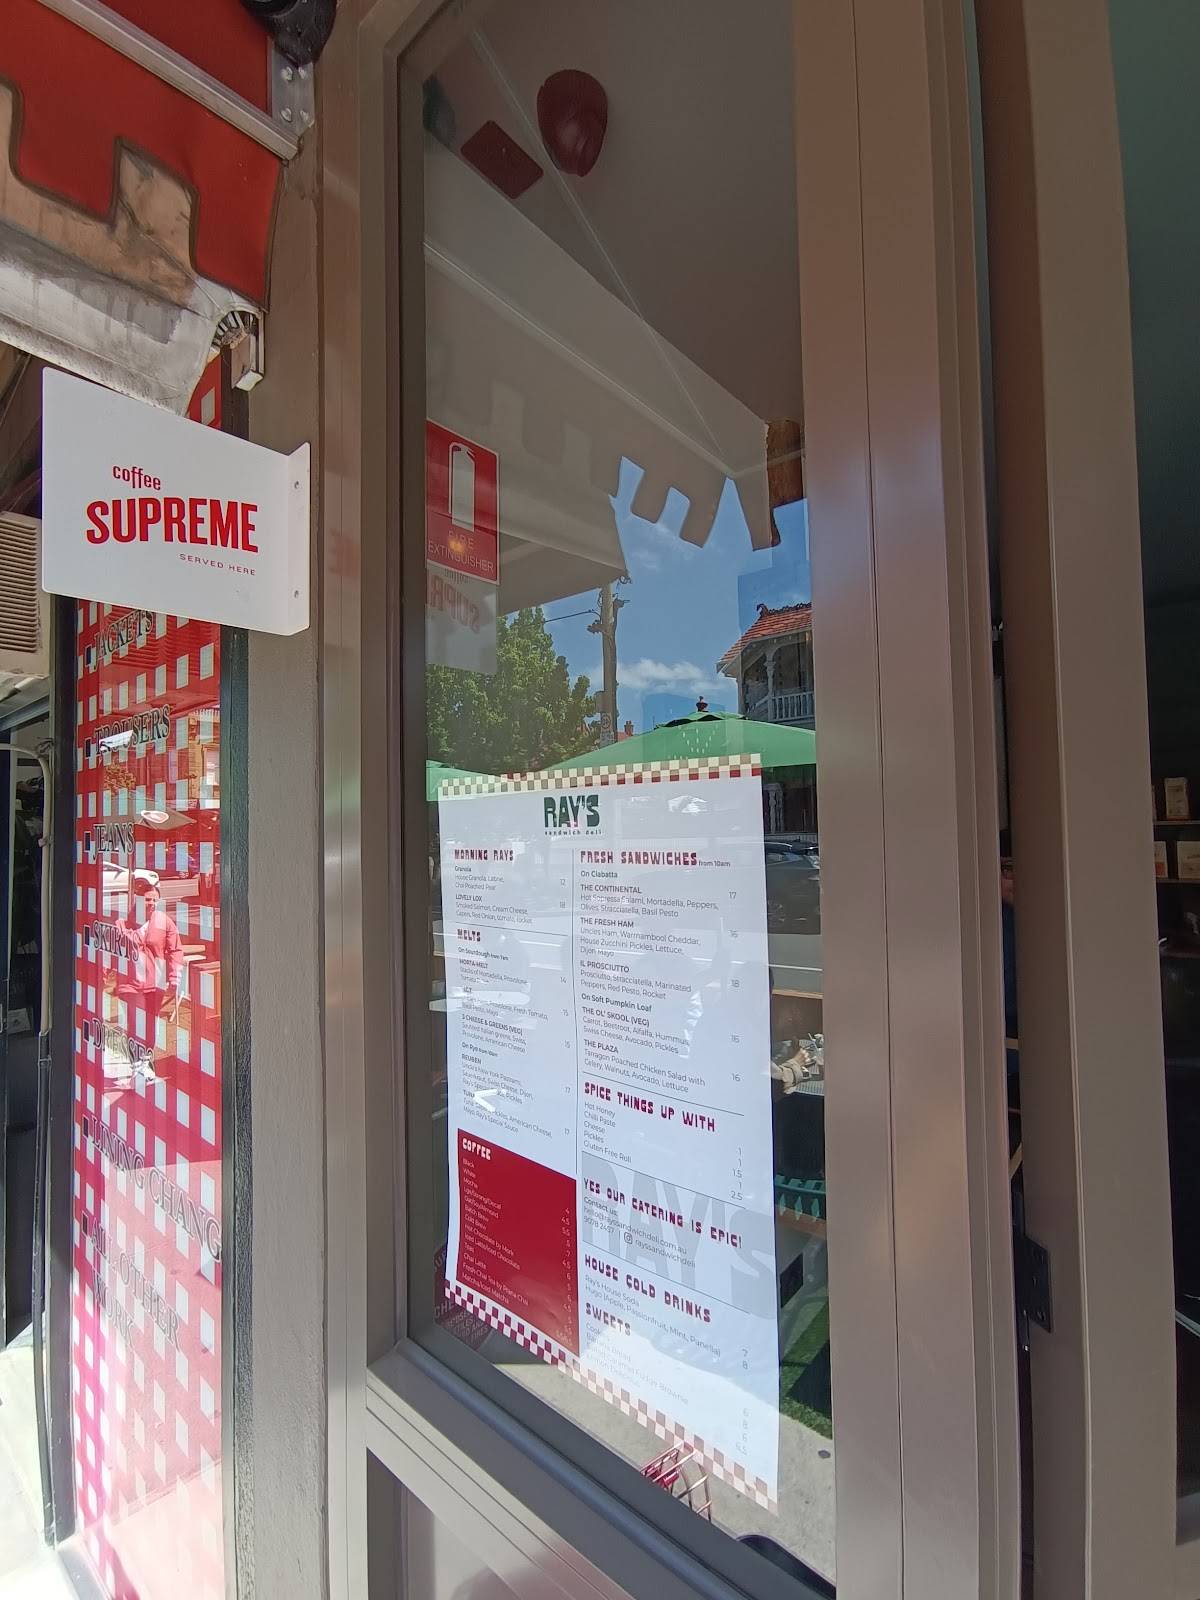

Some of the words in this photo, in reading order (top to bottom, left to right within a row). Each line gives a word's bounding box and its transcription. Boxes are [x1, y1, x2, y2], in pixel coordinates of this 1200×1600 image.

[113, 465, 161, 491] coffee
[86, 497, 259, 553] SUPREME
[179, 553, 224, 569] SERVED
[228, 565, 256, 576] HERE
[428, 540, 494, 572] EXTINGUISHER
[93, 610, 154, 670] JACKETS
[95, 704, 170, 756] TROUSERS
[544, 795, 600, 828] RAY'S
[93, 822, 135, 860] JEANS
[454, 849, 488, 860] MORNING
[493, 849, 514, 861] RAYS
[580, 850, 614, 864] FRESH
[620, 851, 697, 866] SANDWICHES
[591, 870, 618, 878] Ciabatta
[594, 885, 642, 894] CONTINENTAL
[728, 891, 737, 899] 17
[641, 907, 658, 916] Basil
[659, 909, 678, 917] Pesto
[646, 897, 686, 908] Mortadella,
[686, 900, 719, 910] Peppers,
[594, 918, 616, 927] FRESH
[617, 920, 634, 928] HAM
[93, 920, 139, 962] SKIRTS
[457, 928, 481, 942] MELTS
[580, 937, 600, 945] House
[600, 938, 629, 949] Zucchini
[668, 935, 700, 946] Cheddar,
[580, 946, 597, 955] Dijon
[587, 960, 629, 973] PROSCIUTTO
[580, 970, 612, 982] Prosciutto,
[612, 972, 653, 988] Stracciatella,
[655, 980, 691, 992] Marinated
[607, 983, 620, 992] Red
[621, 986, 641, 996] Pesto,
[642, 989, 666, 999] Rocket
[591, 994, 605, 1003] Soft
[605, 997, 635, 1010] Pumpkin
[636, 1001, 652, 1012] Loaf
[582, 1006, 594, 1015] THE
[595, 1009, 606, 1017] OL'
[606, 1011, 630, 1022] SKOOL
[631, 1014, 650, 1028] (VEG)
[603, 1020, 632, 1033] Beetroot,
[583, 1026, 599, 1036] Swiss
[600, 1030, 623, 1041] Cheese,
[624, 1035, 654, 1048] Avocado,
[655, 1042, 679, 1054] Pickles
[584, 1039, 596, 1048] THE
[597, 1041, 619, 1054] PLAZA
[584, 1049, 610, 1061] Tarragon
[611, 1054, 639, 1069] Poached
[639, 1062, 667, 1076] Chicken
[667, 1070, 687, 1082] Salad
[688, 1075, 706, 1086] with
[731, 1073, 740, 1082] 16
[584, 1059, 603, 1071] Celery,
[631, 1070, 660, 1086] Avocado,
[661, 1079, 689, 1093] Lettuce
[584, 1081, 611, 1101] SPICE
[617, 1091, 654, 1115] THINGS
[660, 1105, 675, 1121] UP
[682, 1110, 715, 1132] WITH
[584, 1101, 594, 1110] Hot
[596, 1105, 616, 1119] Honey
[584, 1110, 599, 1122] Chilli
[600, 1115, 616, 1128] Paste
[584, 1120, 606, 1134] Cheese
[583, 1130, 605, 1143] Pickles
[92, 1115, 145, 1190] LINING
[462, 1138, 491, 1160] COFFEE
[583, 1140, 604, 1153] Gluten
[604, 1147, 619, 1159] Free
[619, 1152, 632, 1163] Roll
[583, 1196, 609, 1212] Contact
[583, 1177, 601, 1194] YES
[606, 1186, 626, 1206] OUR
[631, 1197, 684, 1228] CATERING
[691, 1218, 702, 1234] IS
[710, 1226, 742, 1249] EPIC!
[635, 1238, 696, 1268] rayssandwichdeli
[584, 1253, 619, 1282] HOUSE
[626, 1273, 656, 1299] COLD
[664, 1290, 712, 1323] DRINKS
[601, 1281, 622, 1298] House
[622, 1291, 640, 1308] Soda
[119, 1253, 180, 1352] OTHER
[585, 1302, 632, 1336] SWEETS
